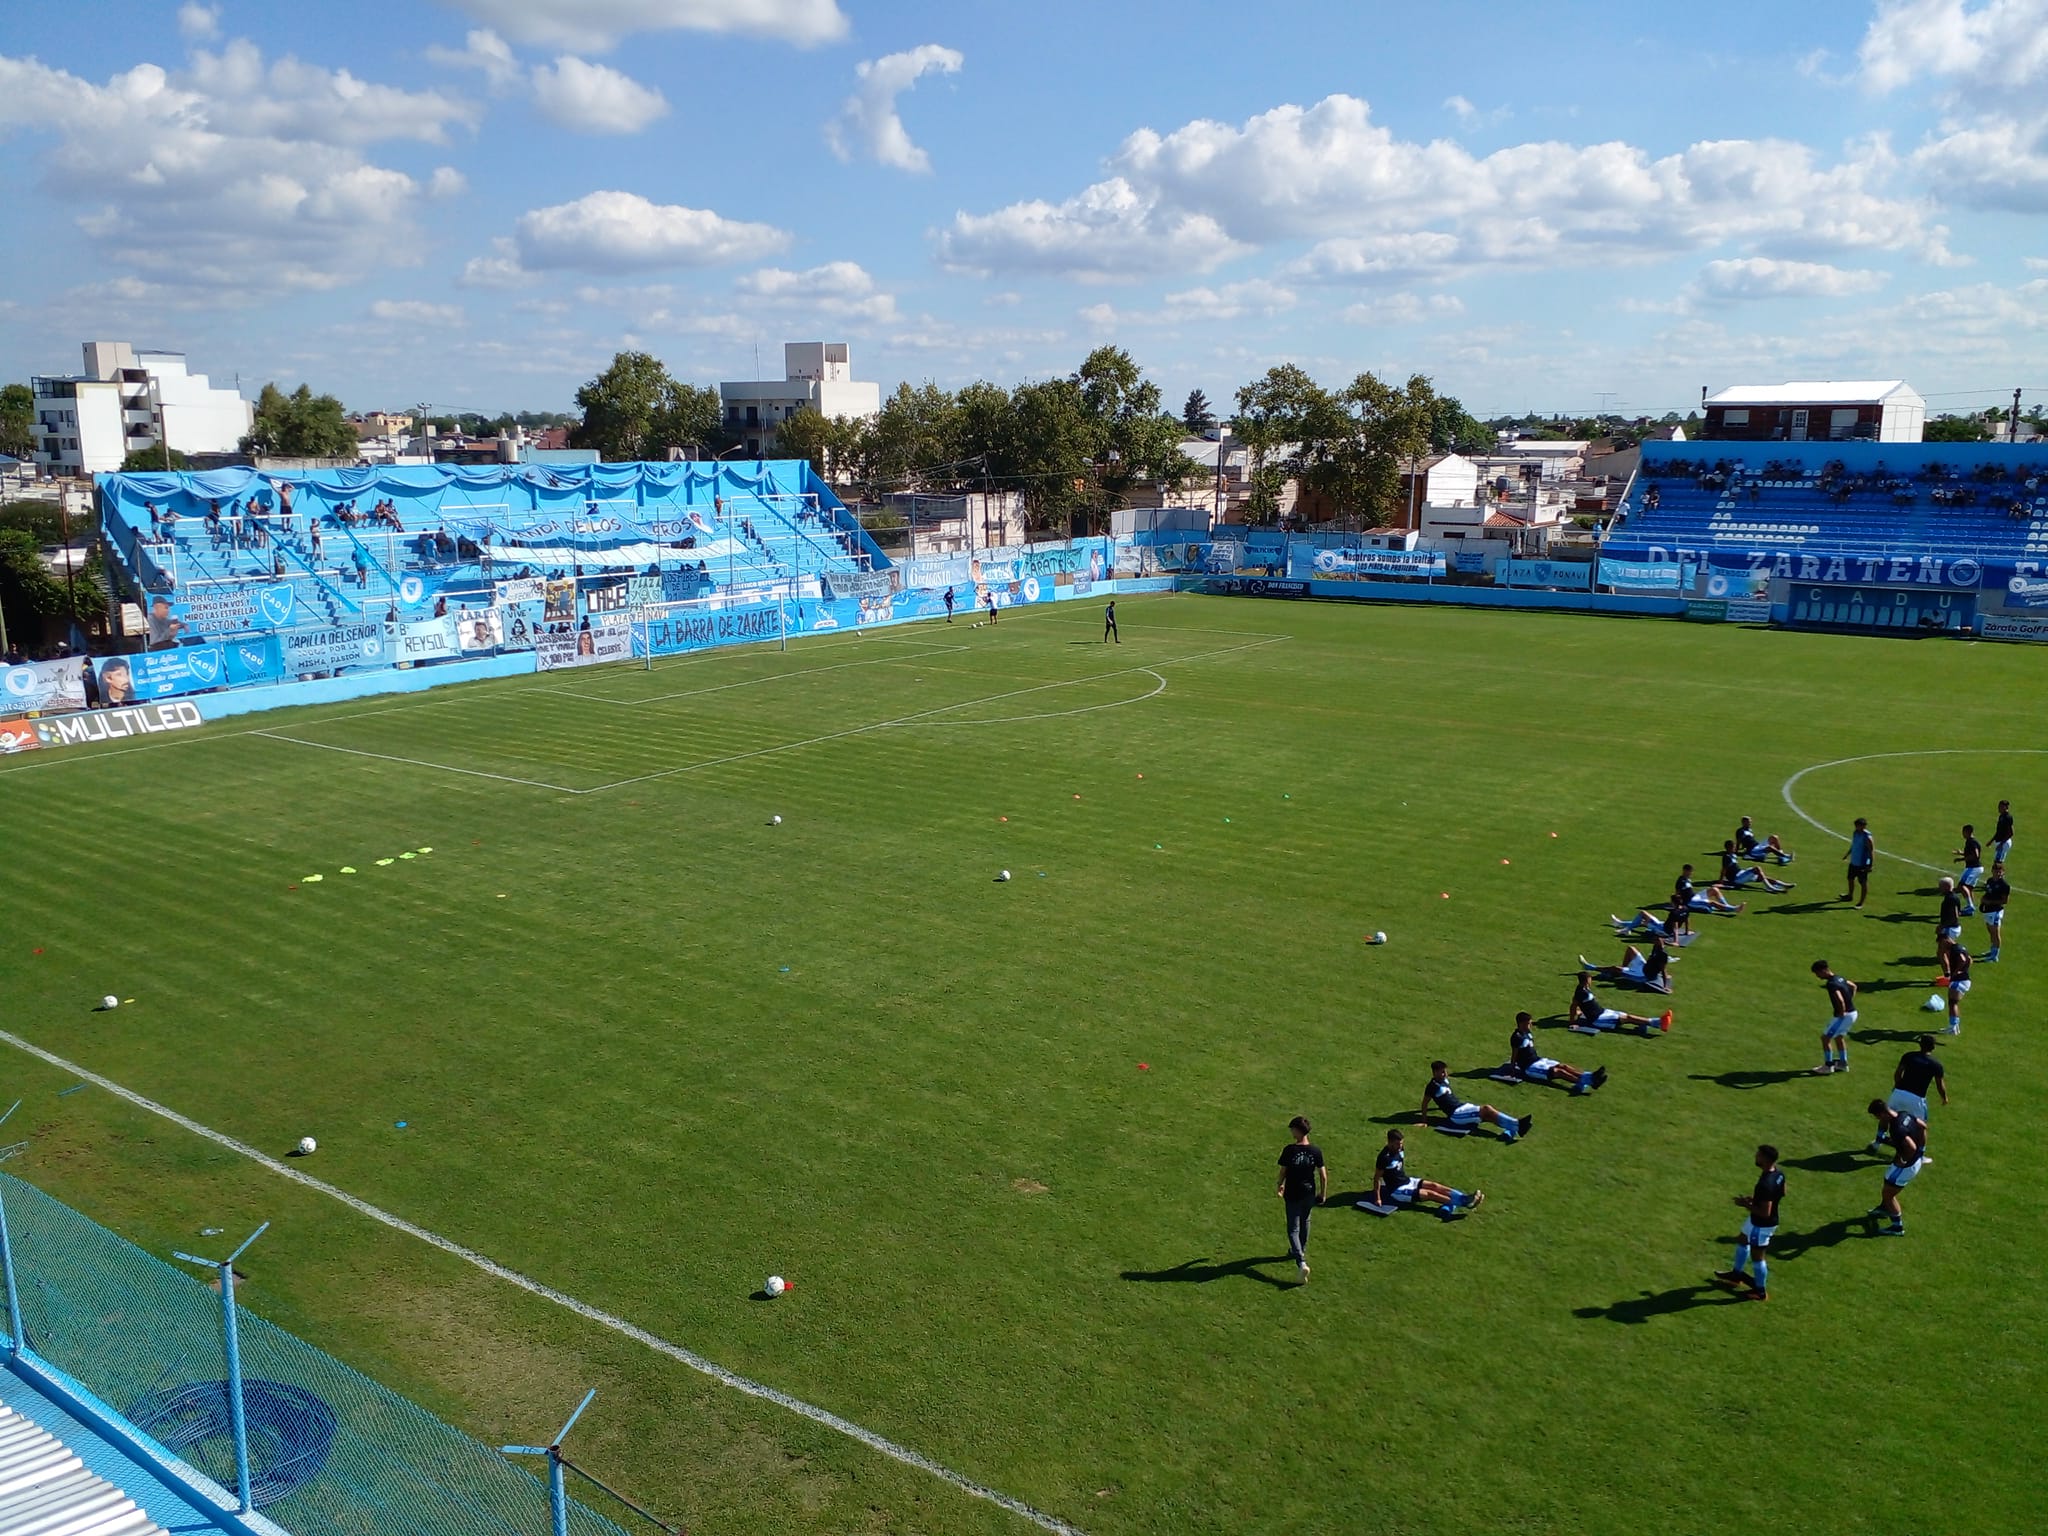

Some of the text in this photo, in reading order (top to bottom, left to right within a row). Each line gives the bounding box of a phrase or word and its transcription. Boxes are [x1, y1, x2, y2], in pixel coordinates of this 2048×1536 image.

[564, 520, 586, 534] DE
[591, 517, 622, 534] LOS
[1343, 551, 1375, 562] Nosotros
[1378, 553, 1400, 563] somos
[1403, 553, 1410, 563] la
[175, 588, 257, 604] BARRIO ZARATE
[264, 592, 288, 614] CADU
[184, 606, 258, 621] MIRO LAS ESTRELLAS
[191, 602, 219, 611] PIENSO
[219, 601, 229, 609] EN
[231, 599, 244, 607] VOS
[198, 619, 236, 632] GASTON
[654, 609, 779, 647] LA BARRA DE ZARATE
[405, 632, 449, 653] REYSOL
[191, 656, 215, 673] CADU
[240, 648, 263, 666] CADU
[56, 701, 202, 744] MULTILED
